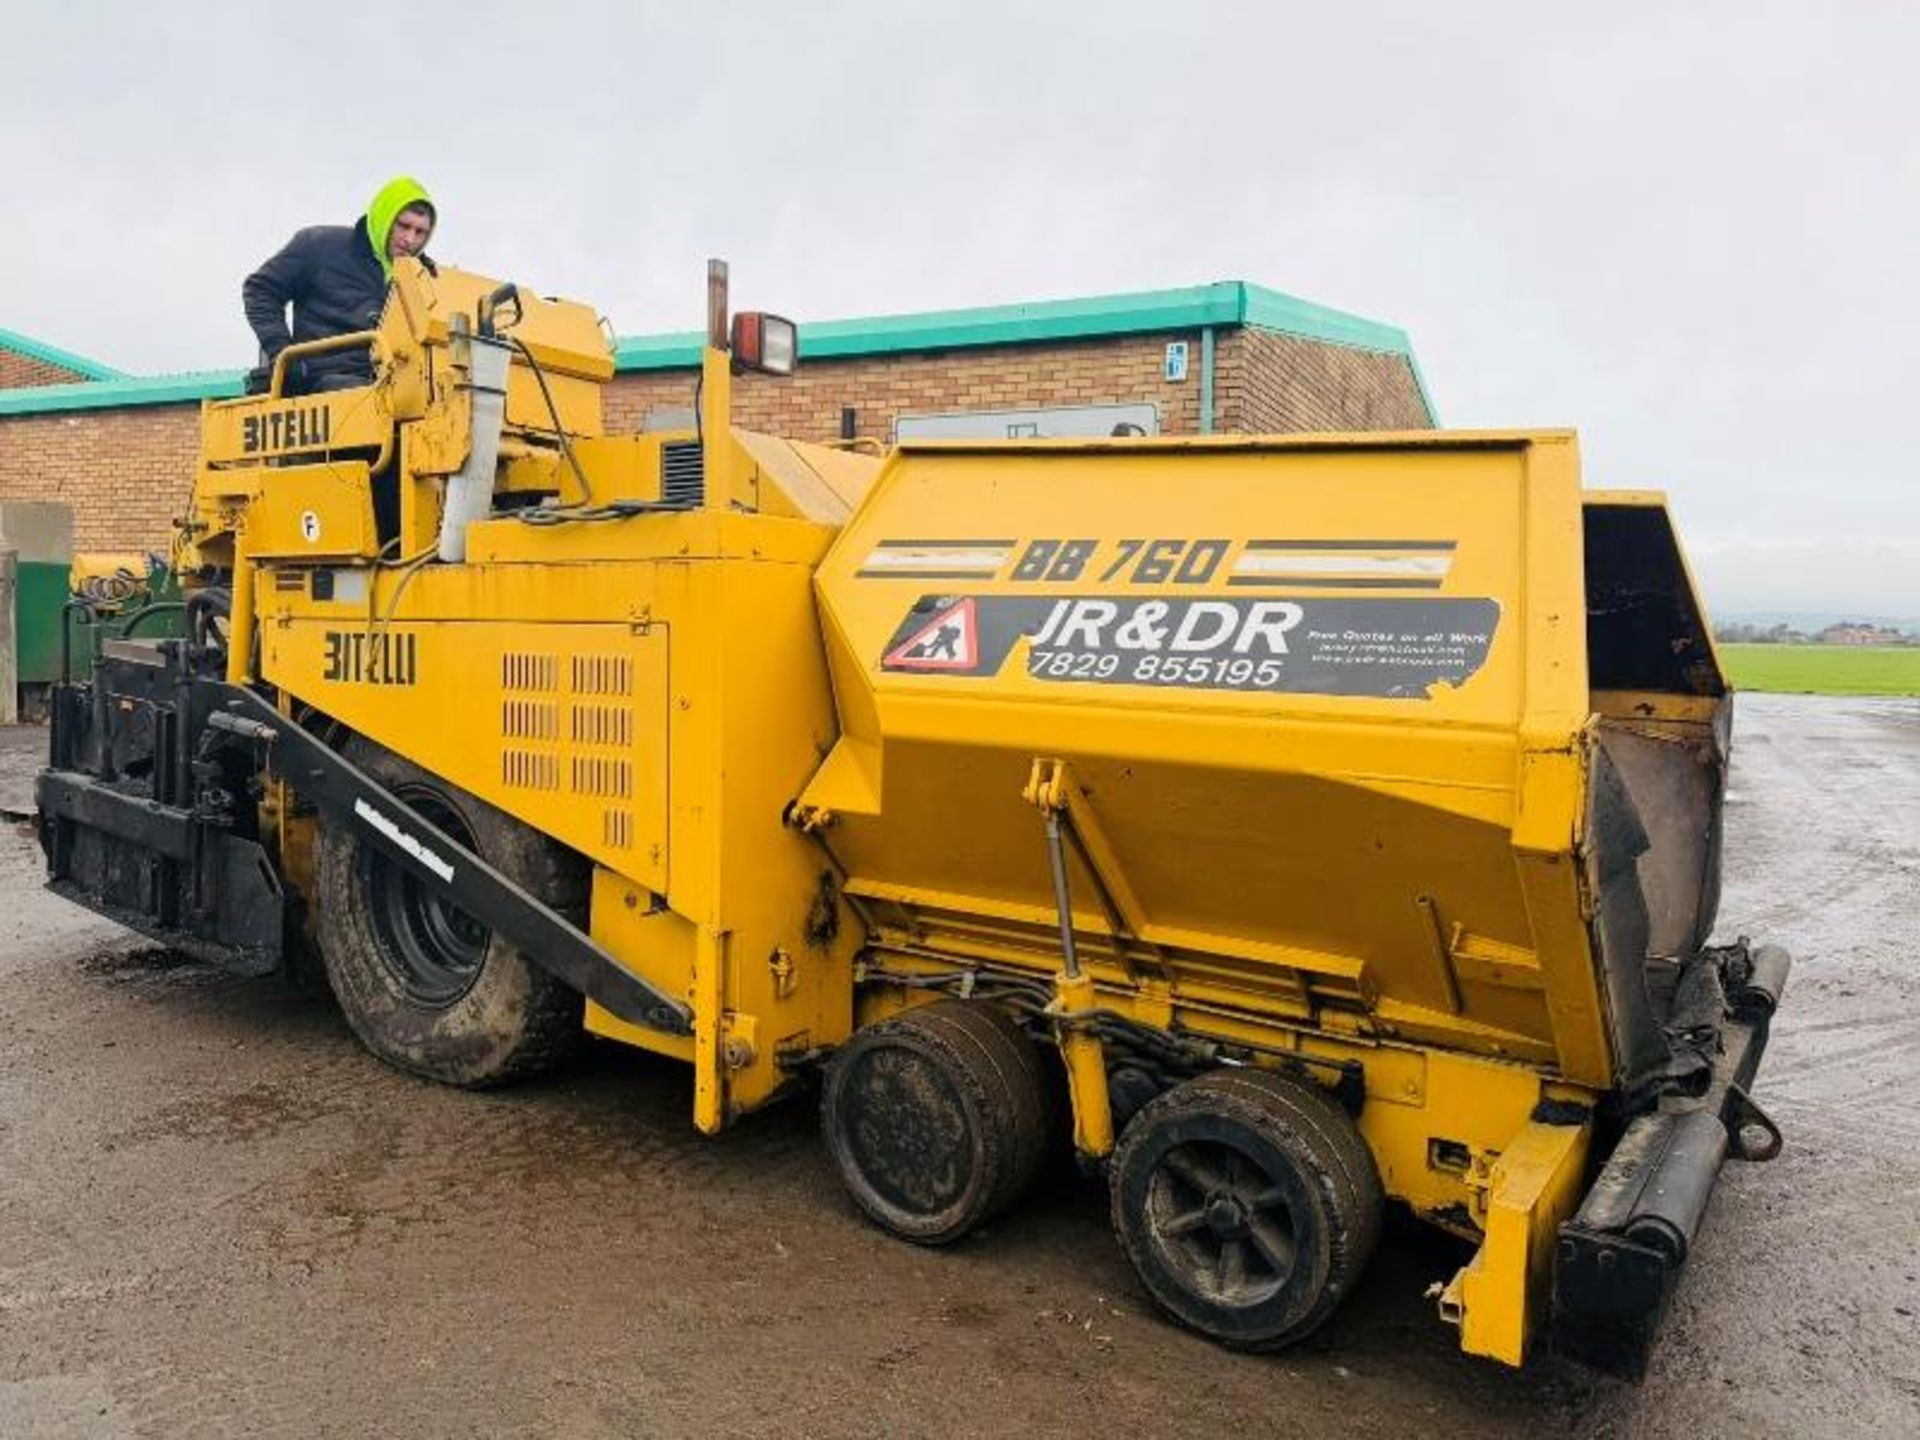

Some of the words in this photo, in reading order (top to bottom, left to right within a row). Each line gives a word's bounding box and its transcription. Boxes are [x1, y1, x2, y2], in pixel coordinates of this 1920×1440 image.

[244, 405, 330, 452] BITELLI
[1099, 539, 1232, 584] 760
[1027, 600, 1304, 654] JR&DR
[324, 632, 415, 685] BITELLI
[1032, 651, 1119, 678] 7829
[1133, 656, 1284, 687] 855195
